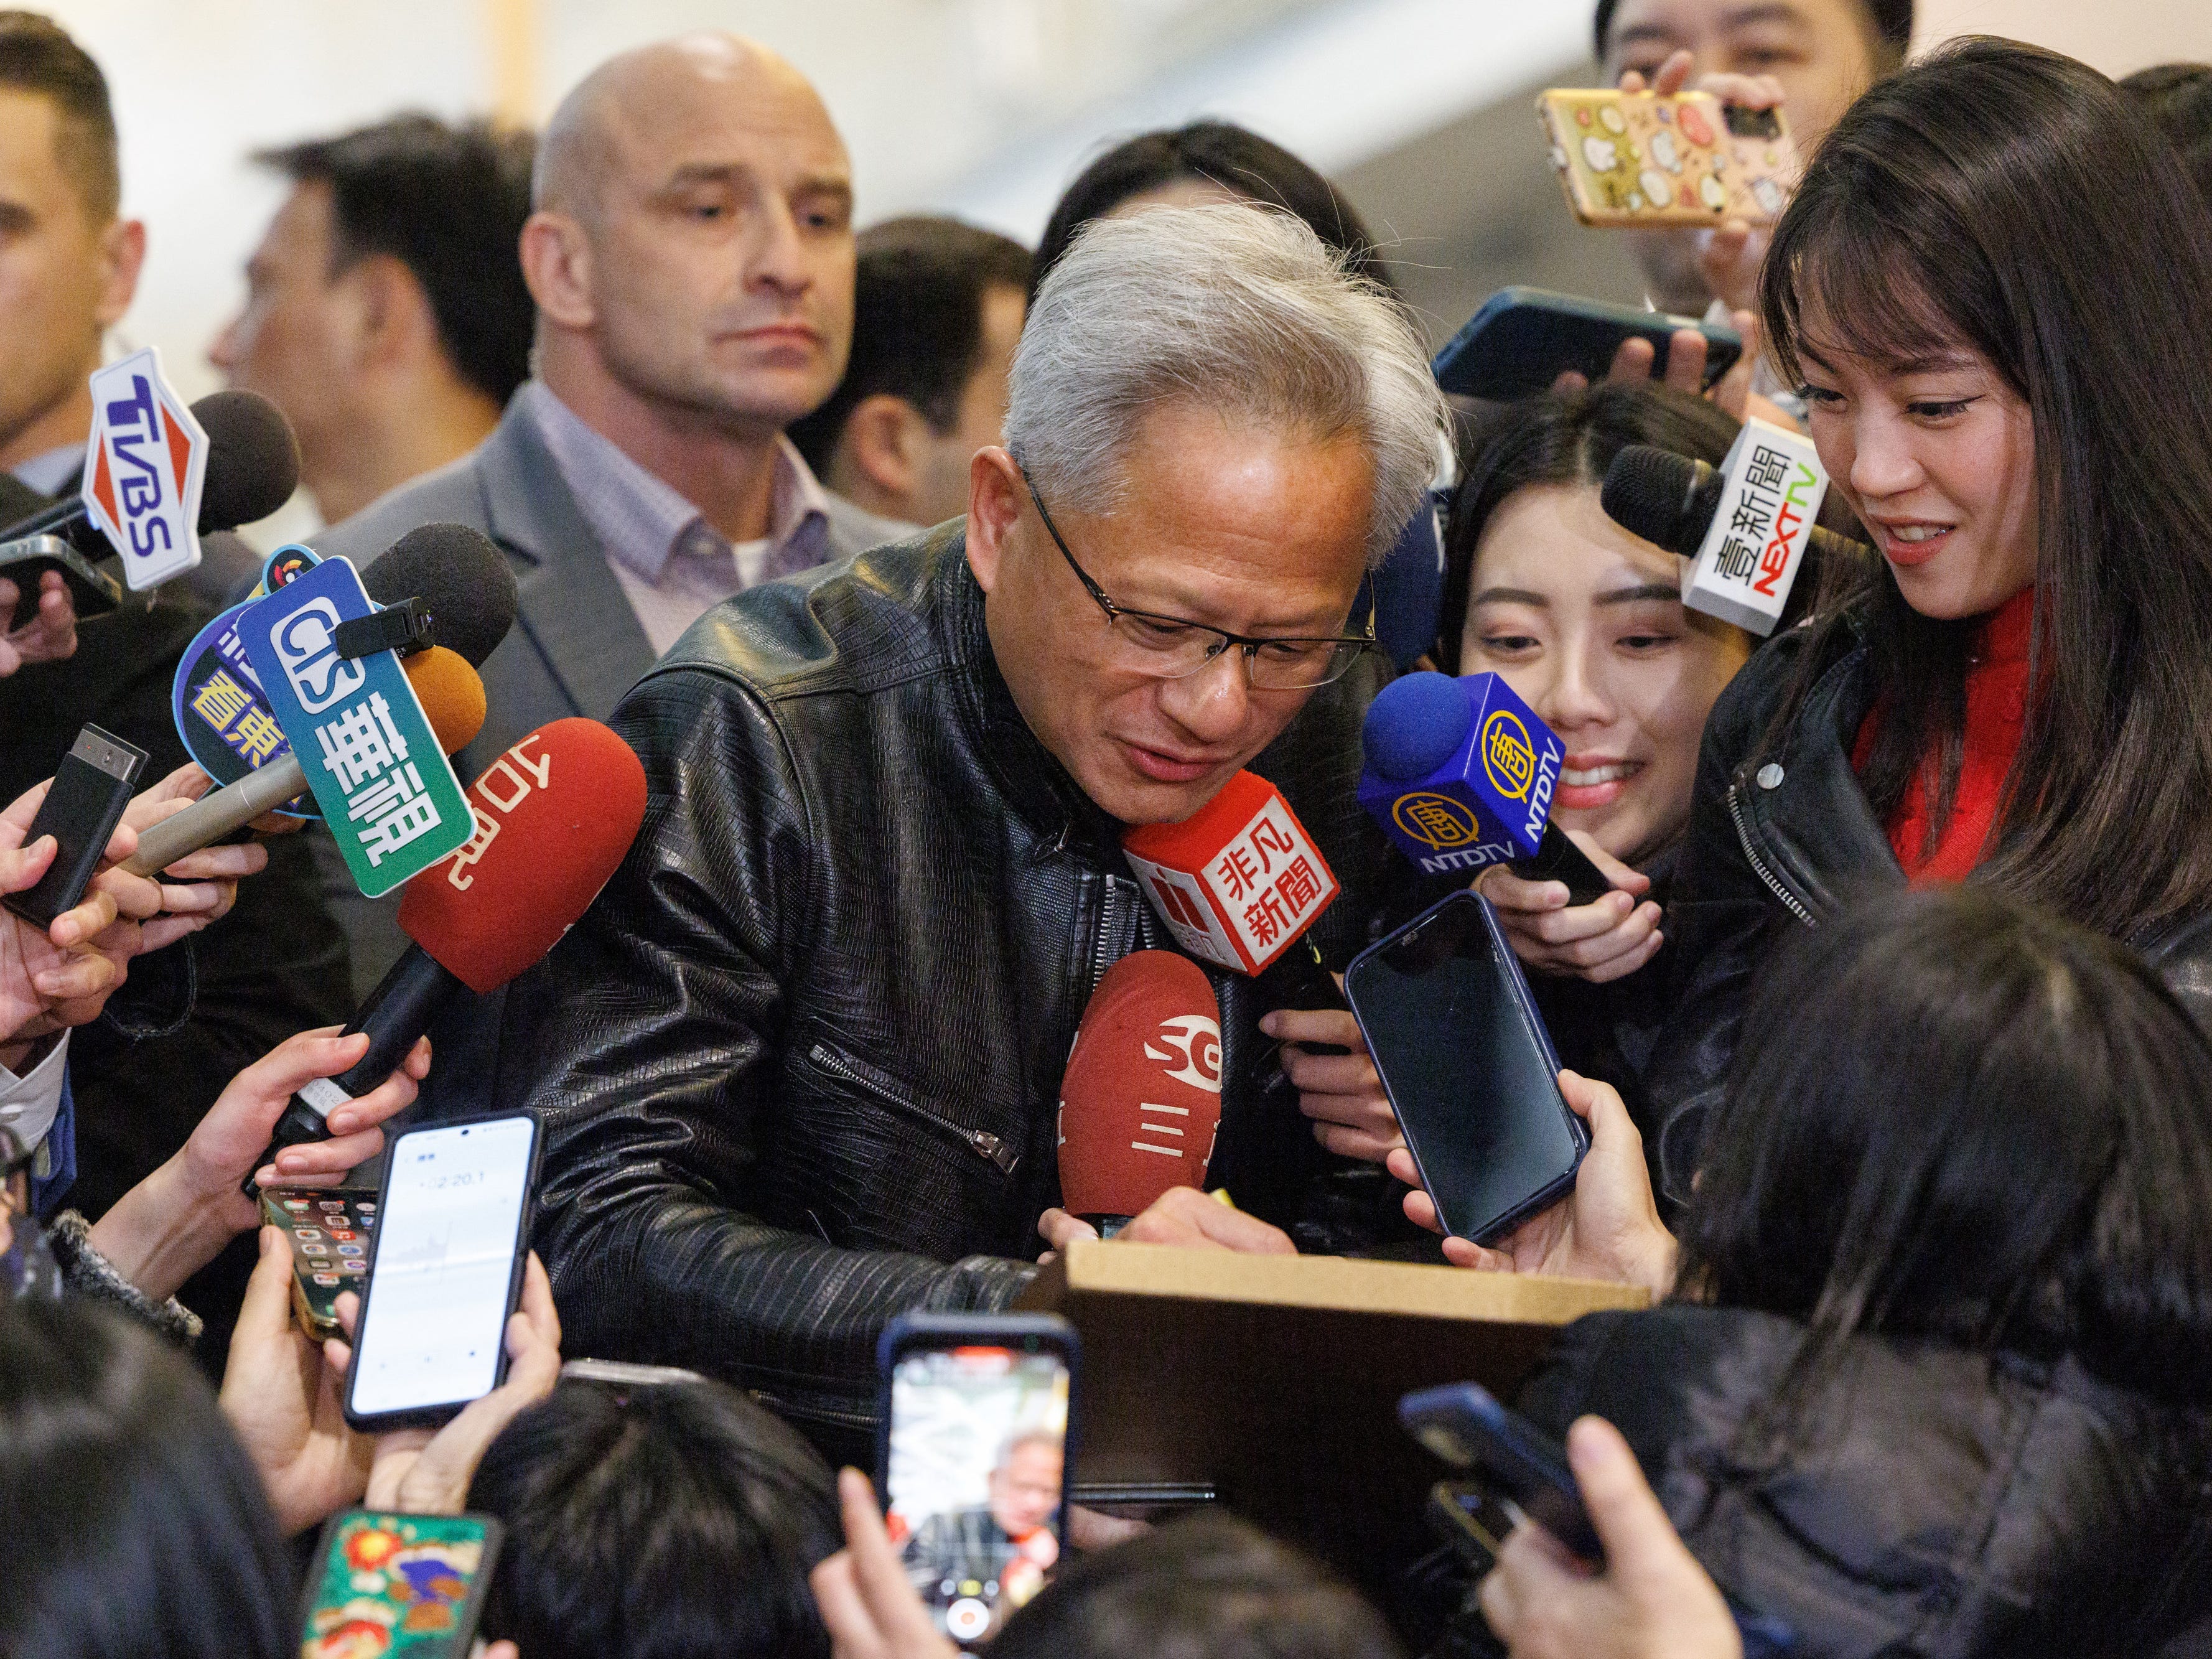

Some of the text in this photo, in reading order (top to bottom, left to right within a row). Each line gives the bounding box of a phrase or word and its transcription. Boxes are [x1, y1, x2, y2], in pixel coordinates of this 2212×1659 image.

[107, 375, 172, 557] TVBS
[1714, 444, 1793, 586] 壹新聞
[193, 670, 292, 770] 看東
[314, 691, 442, 867] 華視
[1525, 737, 1560, 843] NTDTV
[1218, 817, 1294, 901] 非凡
[1243, 854, 1322, 947] 新聞
[1421, 841, 1515, 873] NTDTV
[1132, 1102, 1198, 1161] 三
